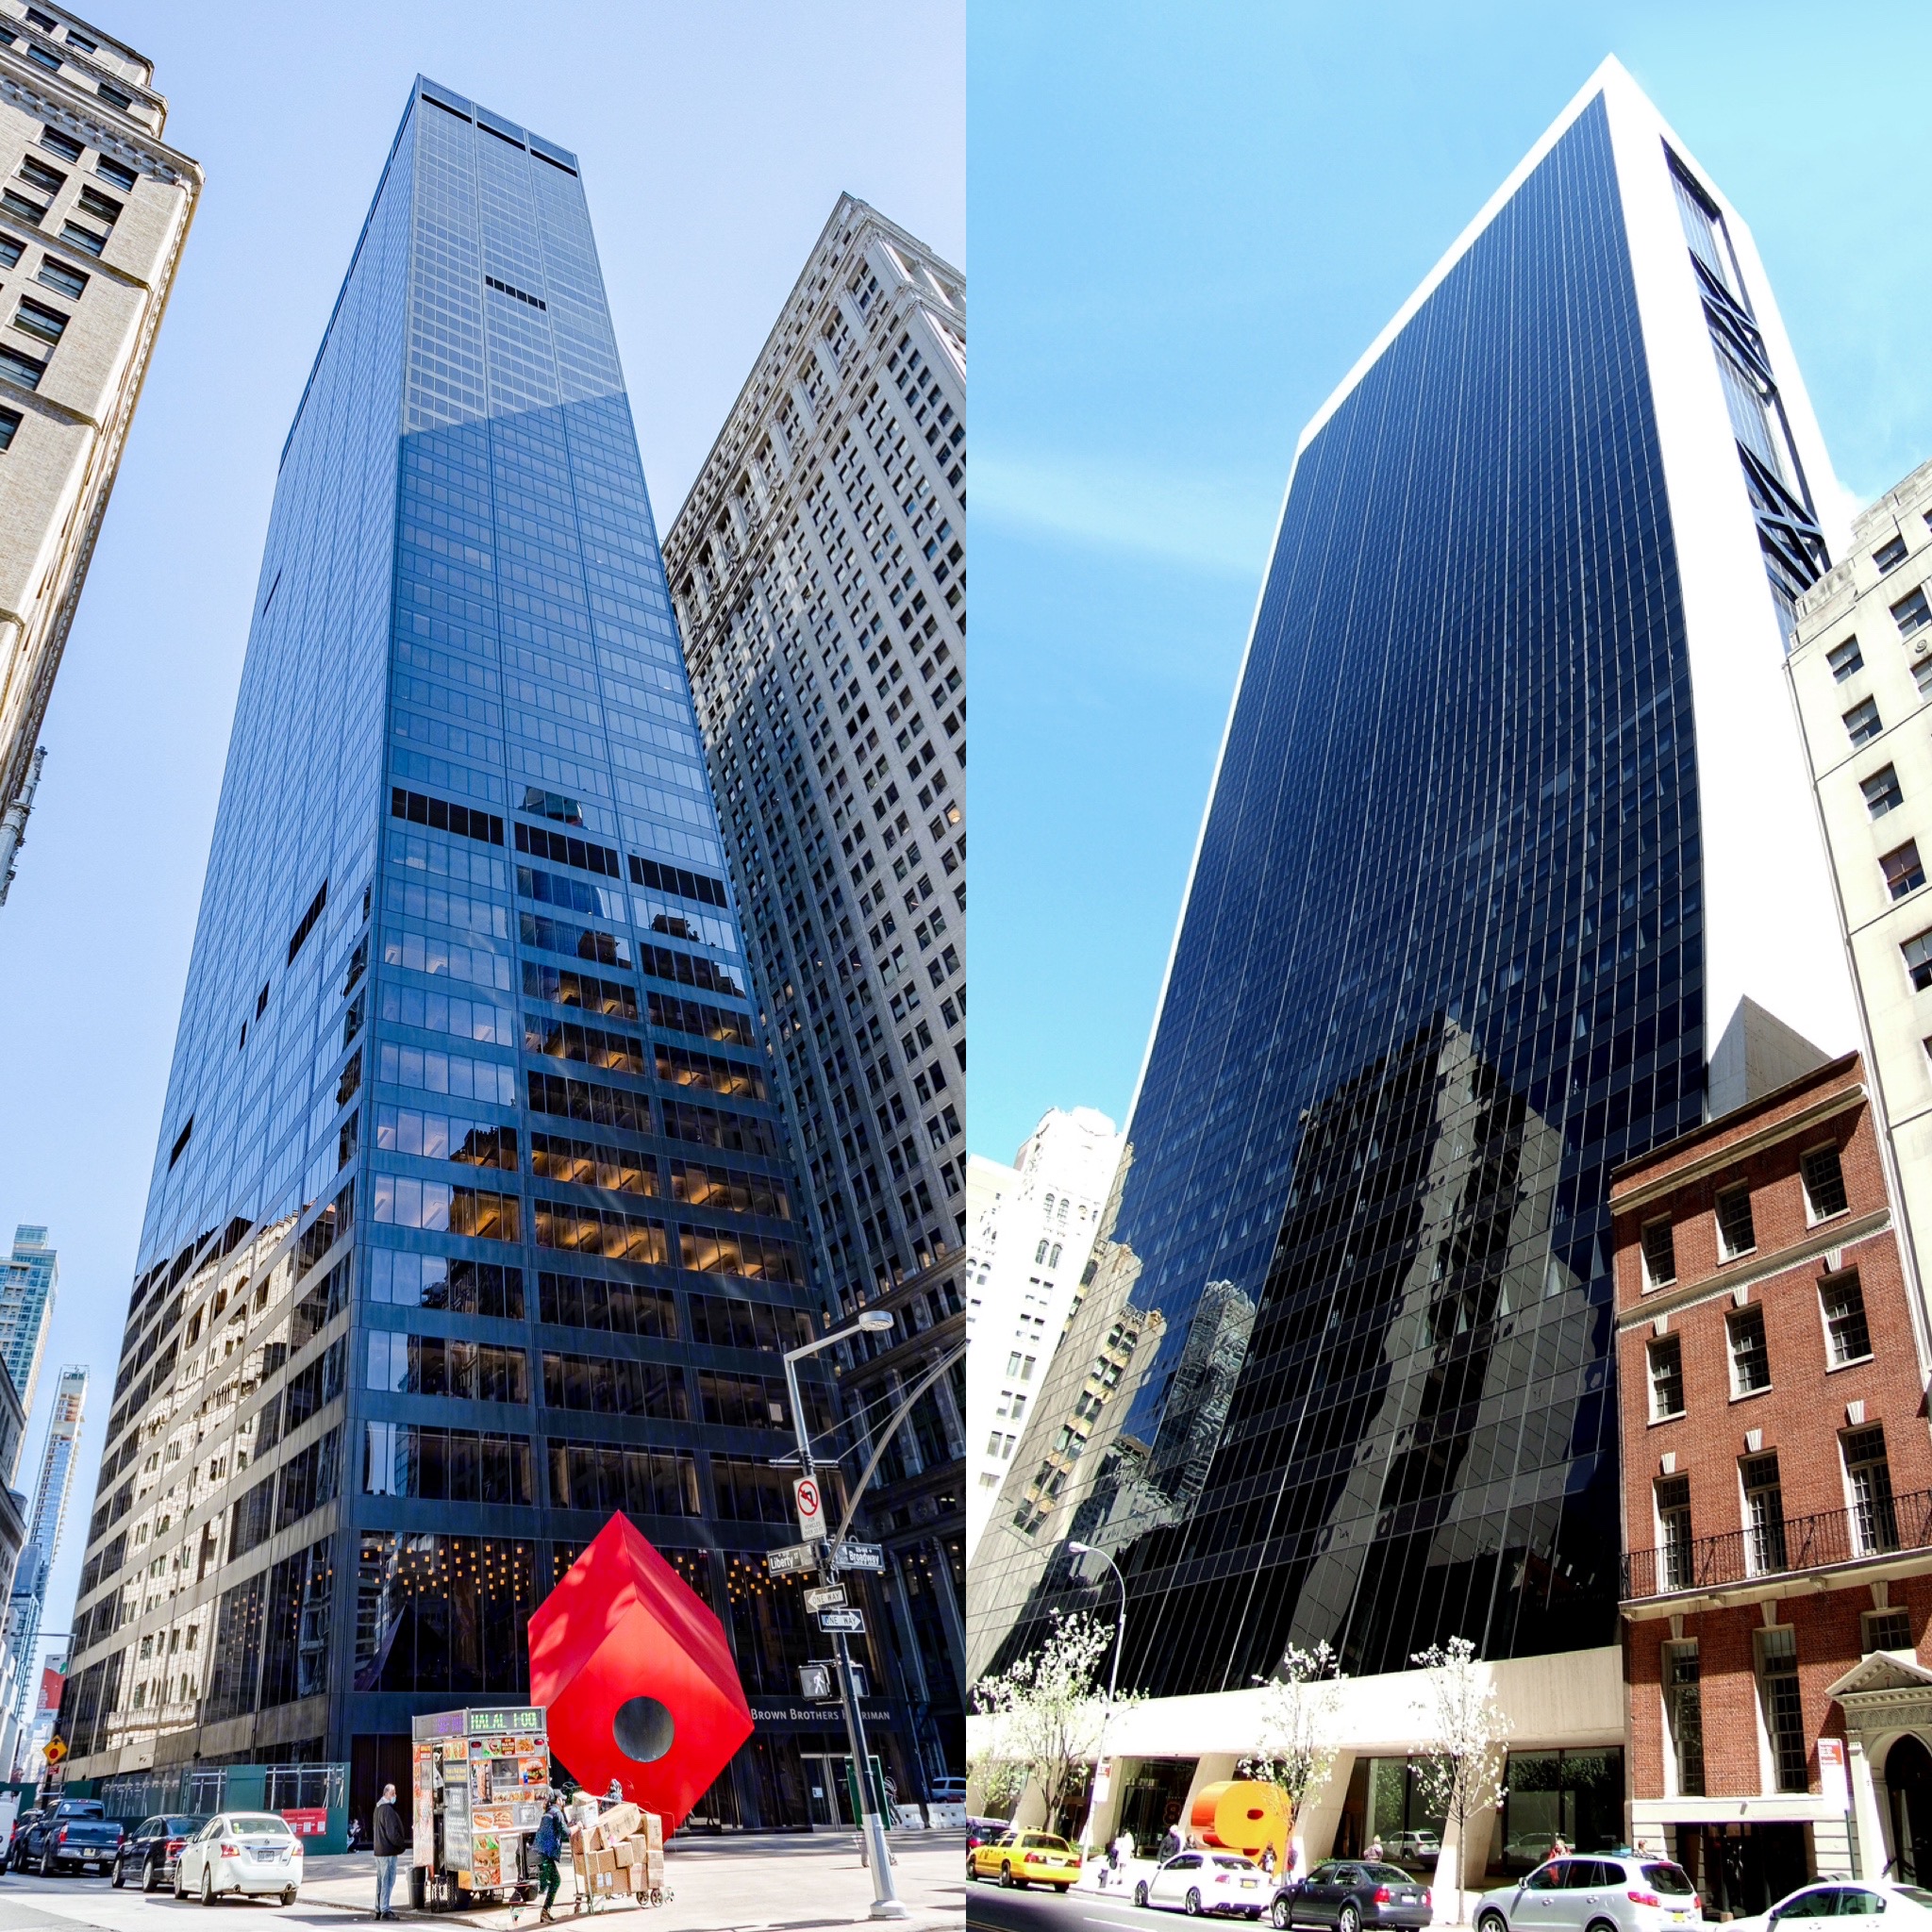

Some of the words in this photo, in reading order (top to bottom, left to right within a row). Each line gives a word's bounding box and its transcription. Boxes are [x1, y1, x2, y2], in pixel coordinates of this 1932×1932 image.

[770, 1556, 793, 1570] Liberty
[849, 1550, 879, 1566] Broadway
[812, 1594, 825, 1605] ONE
[827, 1591, 841, 1602] WAY
[824, 1615, 839, 1625] ONE
[843, 1615, 857, 1625] WAY
[471, 1713, 508, 1730] HALAL
